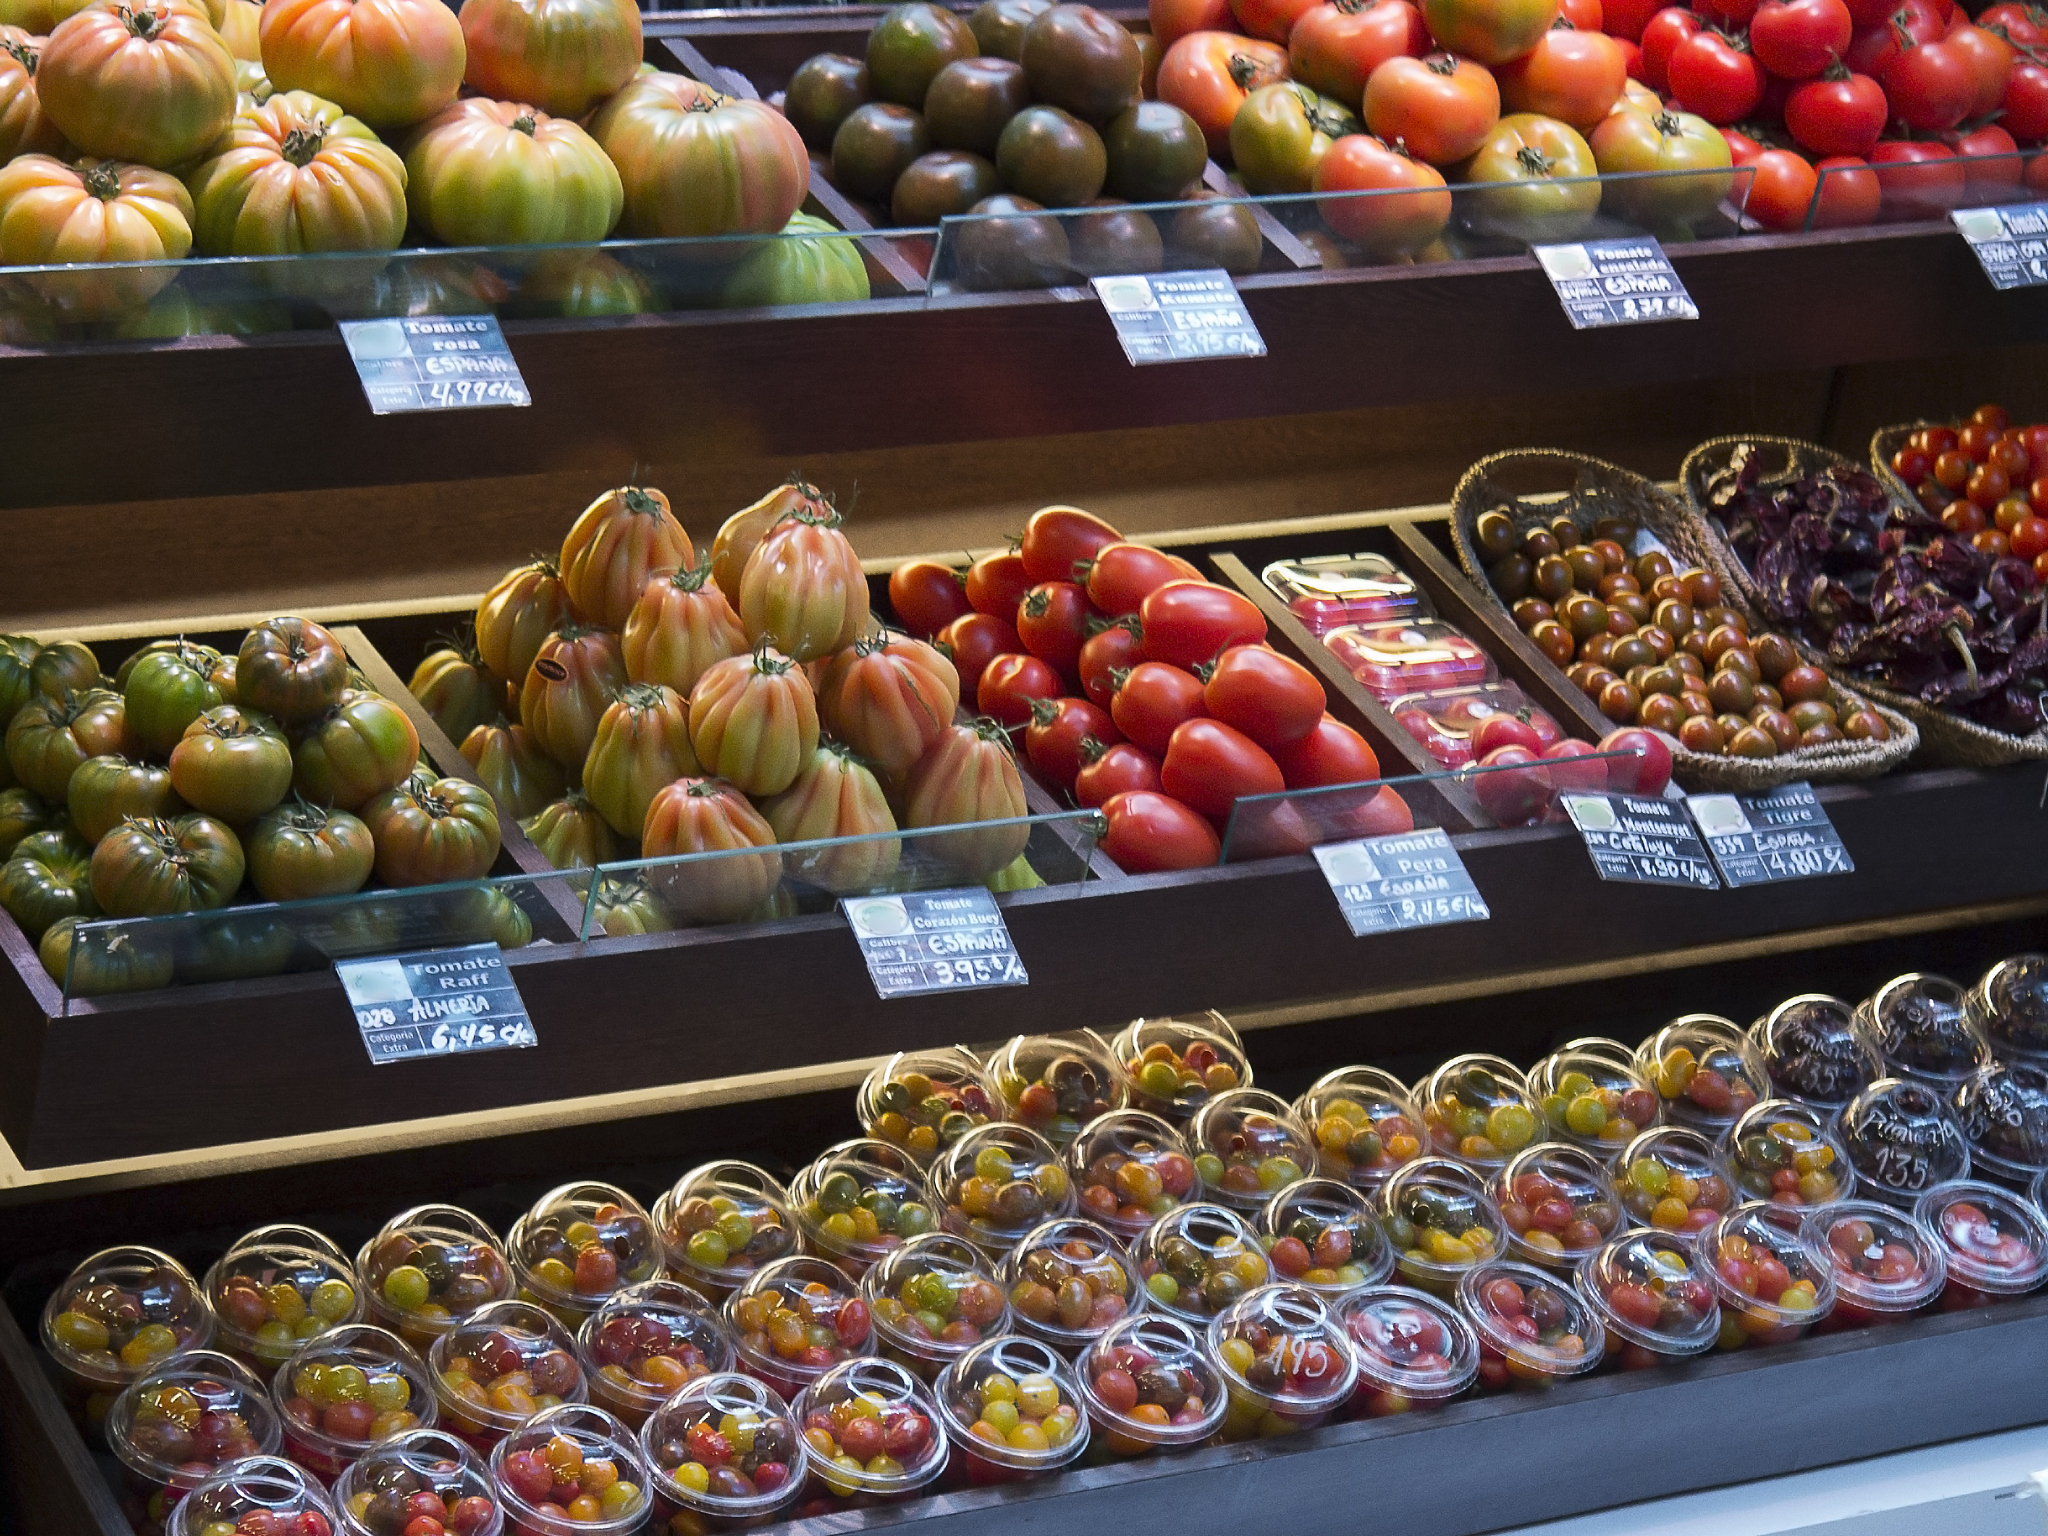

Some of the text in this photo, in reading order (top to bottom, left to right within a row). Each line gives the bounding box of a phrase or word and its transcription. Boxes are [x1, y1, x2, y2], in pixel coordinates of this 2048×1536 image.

[1594, 246, 1653, 260] Tomate
[1153, 280, 1225, 292] Tomate
[406, 320, 488, 334] Tomate
[432, 338, 481, 351] rosa
[426, 355, 509, 375] ESPAÑA
[1622, 796, 1670, 816] Tomate
[1743, 792, 1816, 810] Tomate
[1763, 808, 1813, 825] Tigre
[1367, 834, 1449, 857] Tomate
[1397, 857, 1448, 875] Pera
[924, 898, 974, 911] Tomate
[914, 908, 1000, 929] Corazón Buey
[408, 957, 501, 976] Tomate
[439, 972, 490, 989] Raff
[431, 1023, 496, 1052] 6,45
[383, 1043, 409, 1054] Extra
